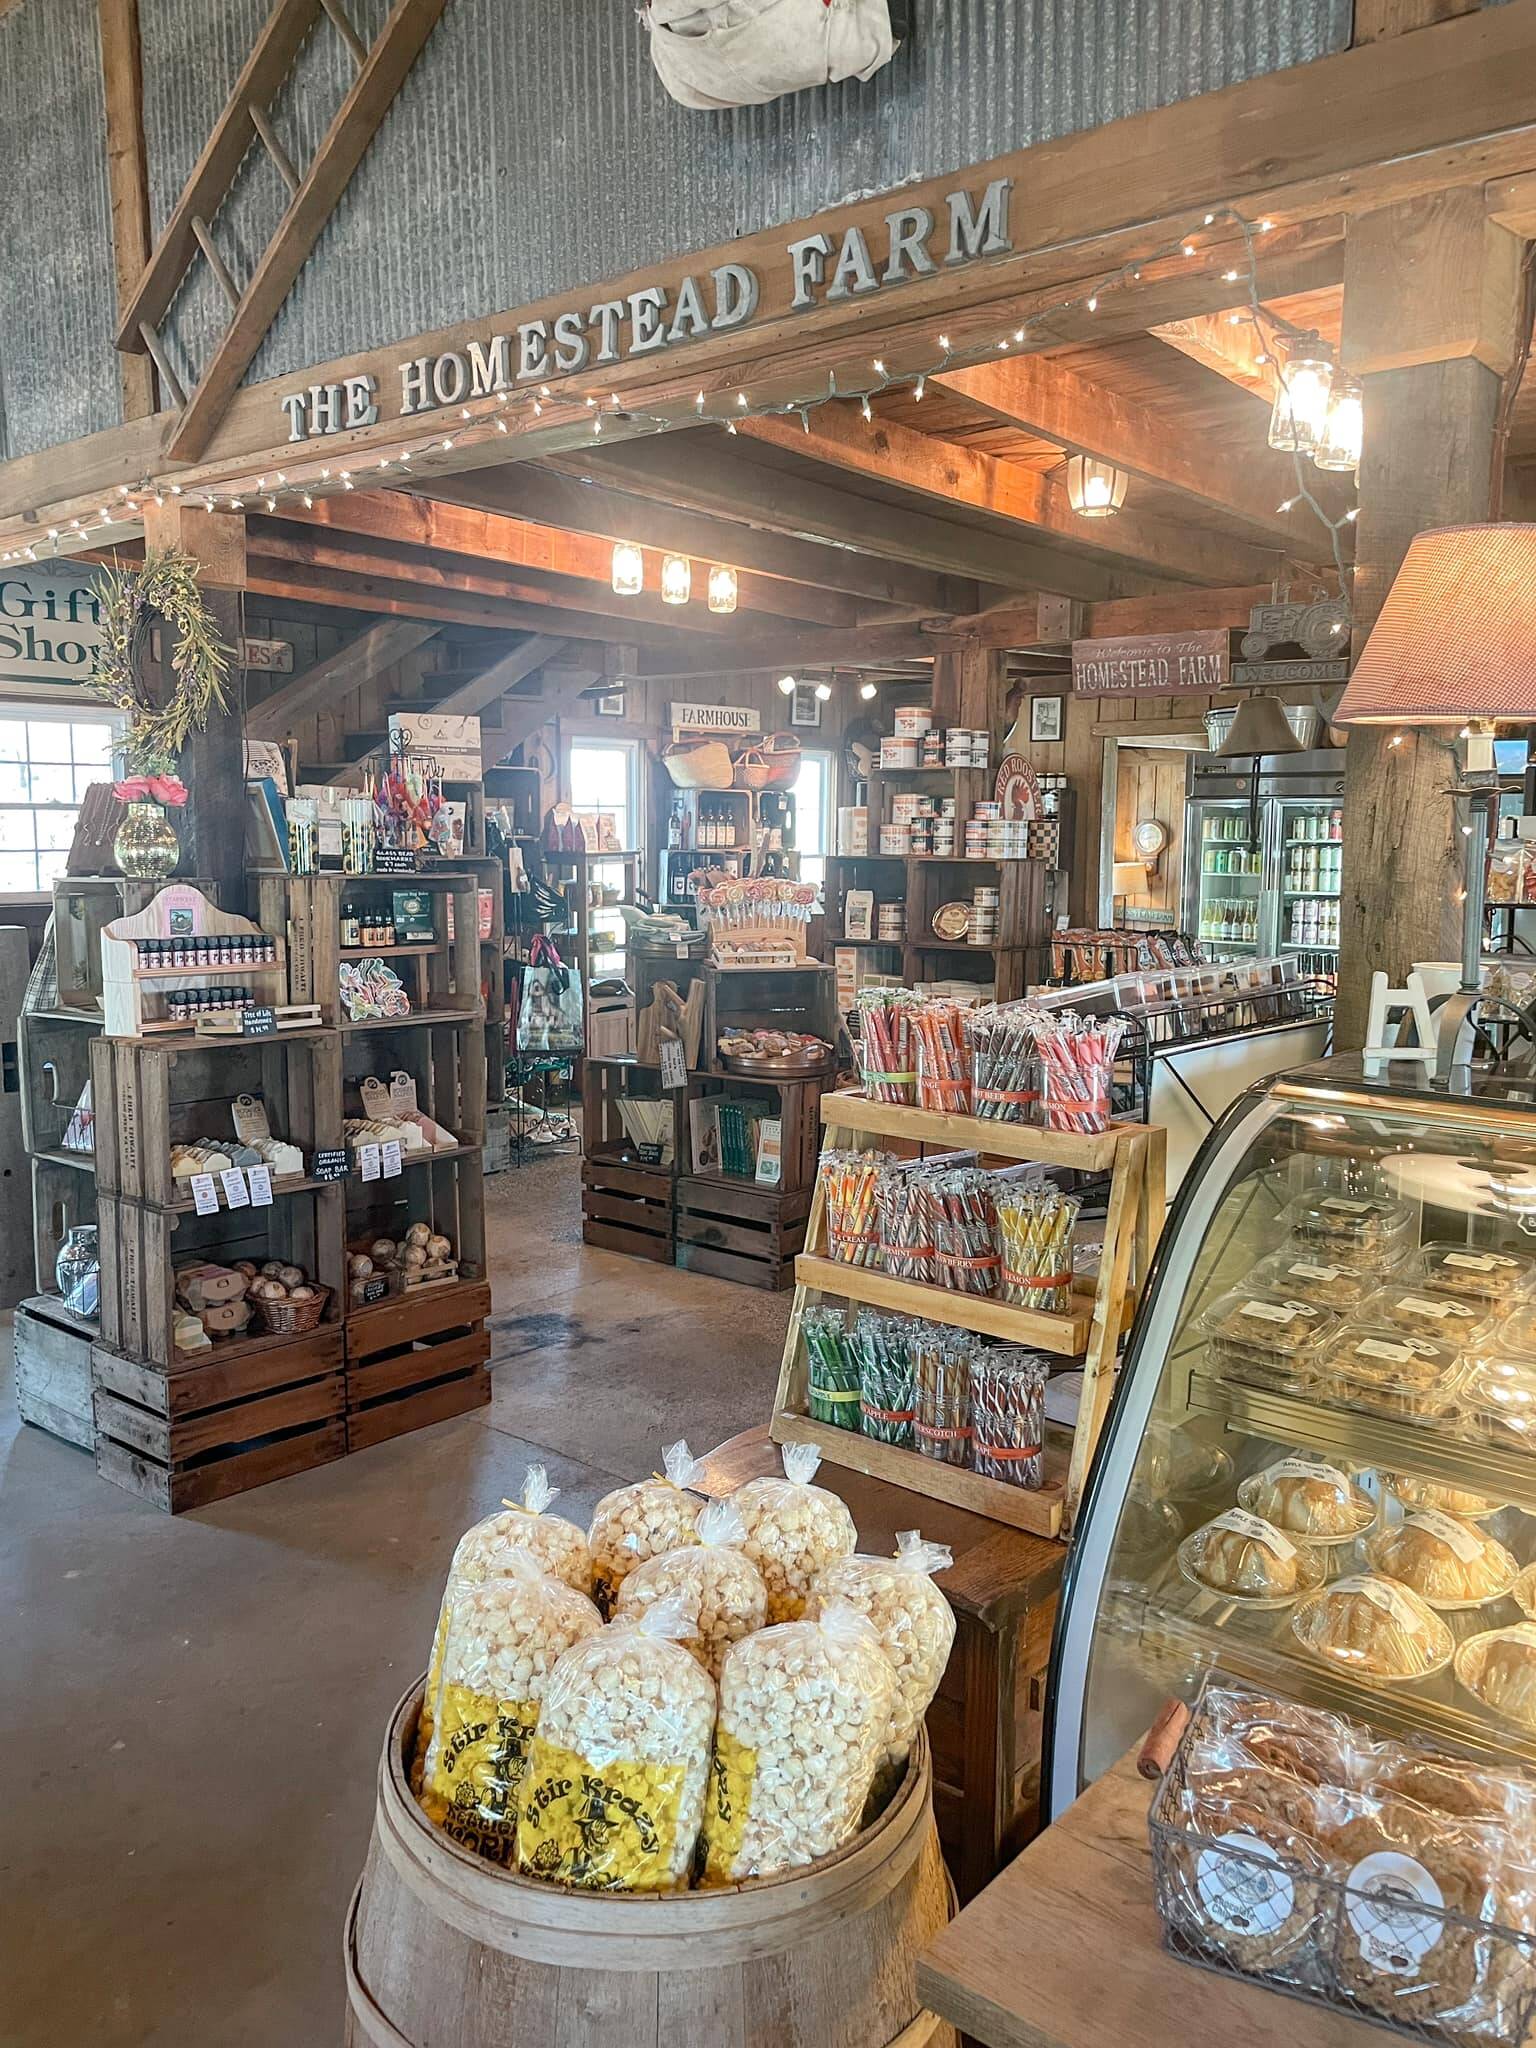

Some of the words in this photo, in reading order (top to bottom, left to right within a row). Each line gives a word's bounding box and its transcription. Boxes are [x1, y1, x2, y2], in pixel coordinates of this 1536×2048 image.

[281, 374, 379, 442] THE
[399, 263, 759, 415] HOMESTEAD
[787, 176, 1014, 312] FARM
[0, 581, 108, 626] Gift
[1076, 658, 1169, 691] HOMESTEAD
[1178, 655, 1222, 685] FARM
[1247, 664, 1341, 682] WELCOME
[682, 708, 752, 727] FARMHOUSE
[998, 764, 1010, 795] RED
[443, 1720, 489, 1774] Stir
[526, 1777, 573, 1829] Stir
[580, 1774, 661, 1855] Krazy
